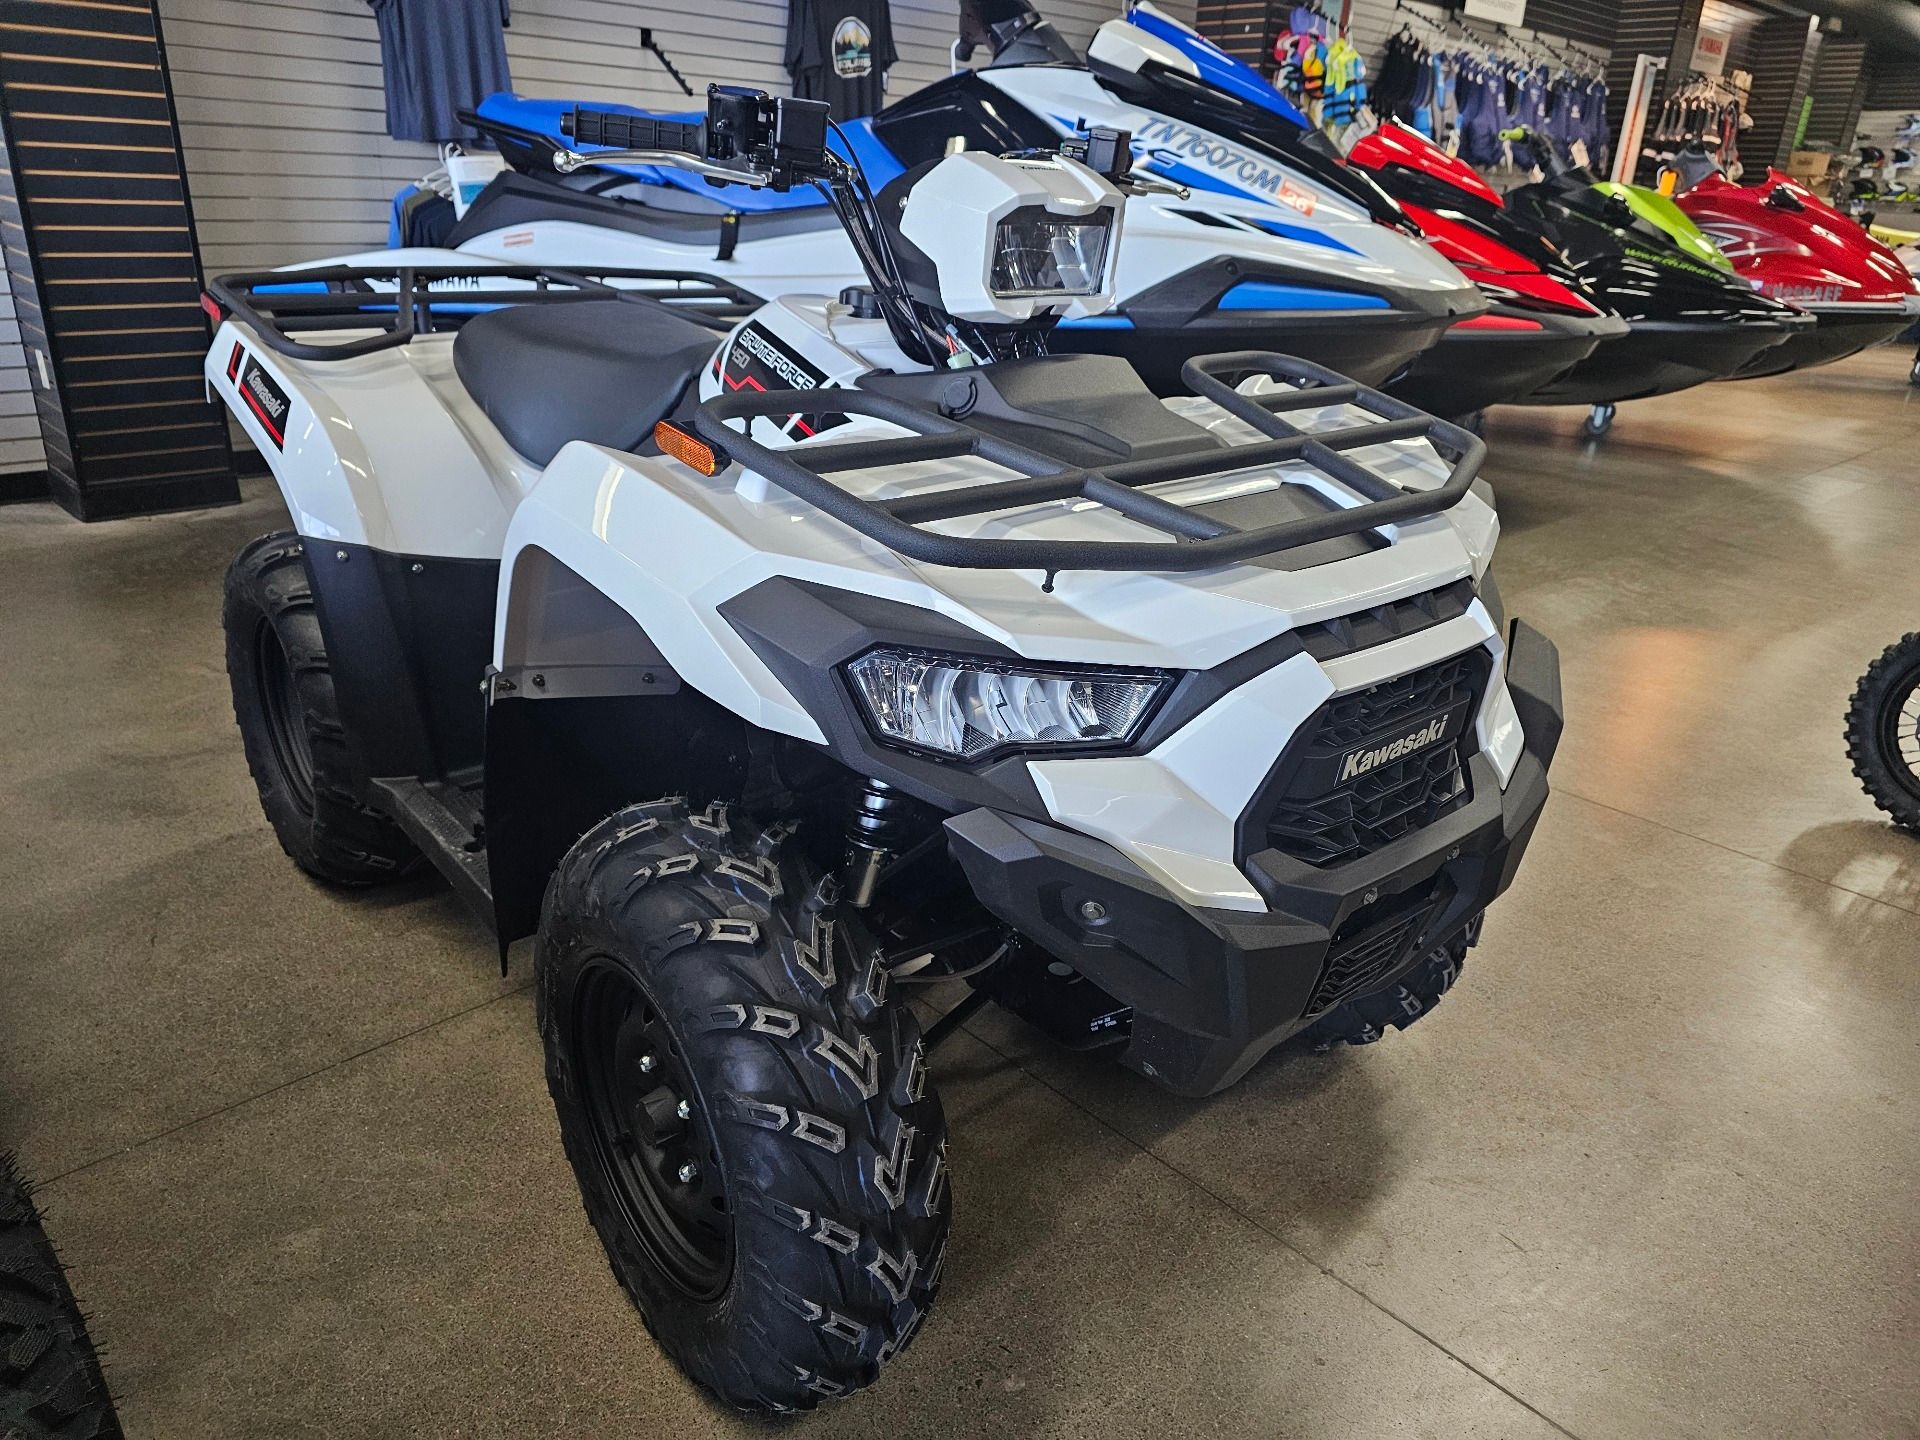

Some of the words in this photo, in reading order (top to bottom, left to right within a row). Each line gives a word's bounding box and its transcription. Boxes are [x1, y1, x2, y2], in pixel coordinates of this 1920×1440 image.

[1138, 116, 1282, 194] TN7607CM
[731, 345, 751, 369] 450
[246, 367, 286, 418] Kawasaki
[1341, 714, 1449, 781] Kawasaki
